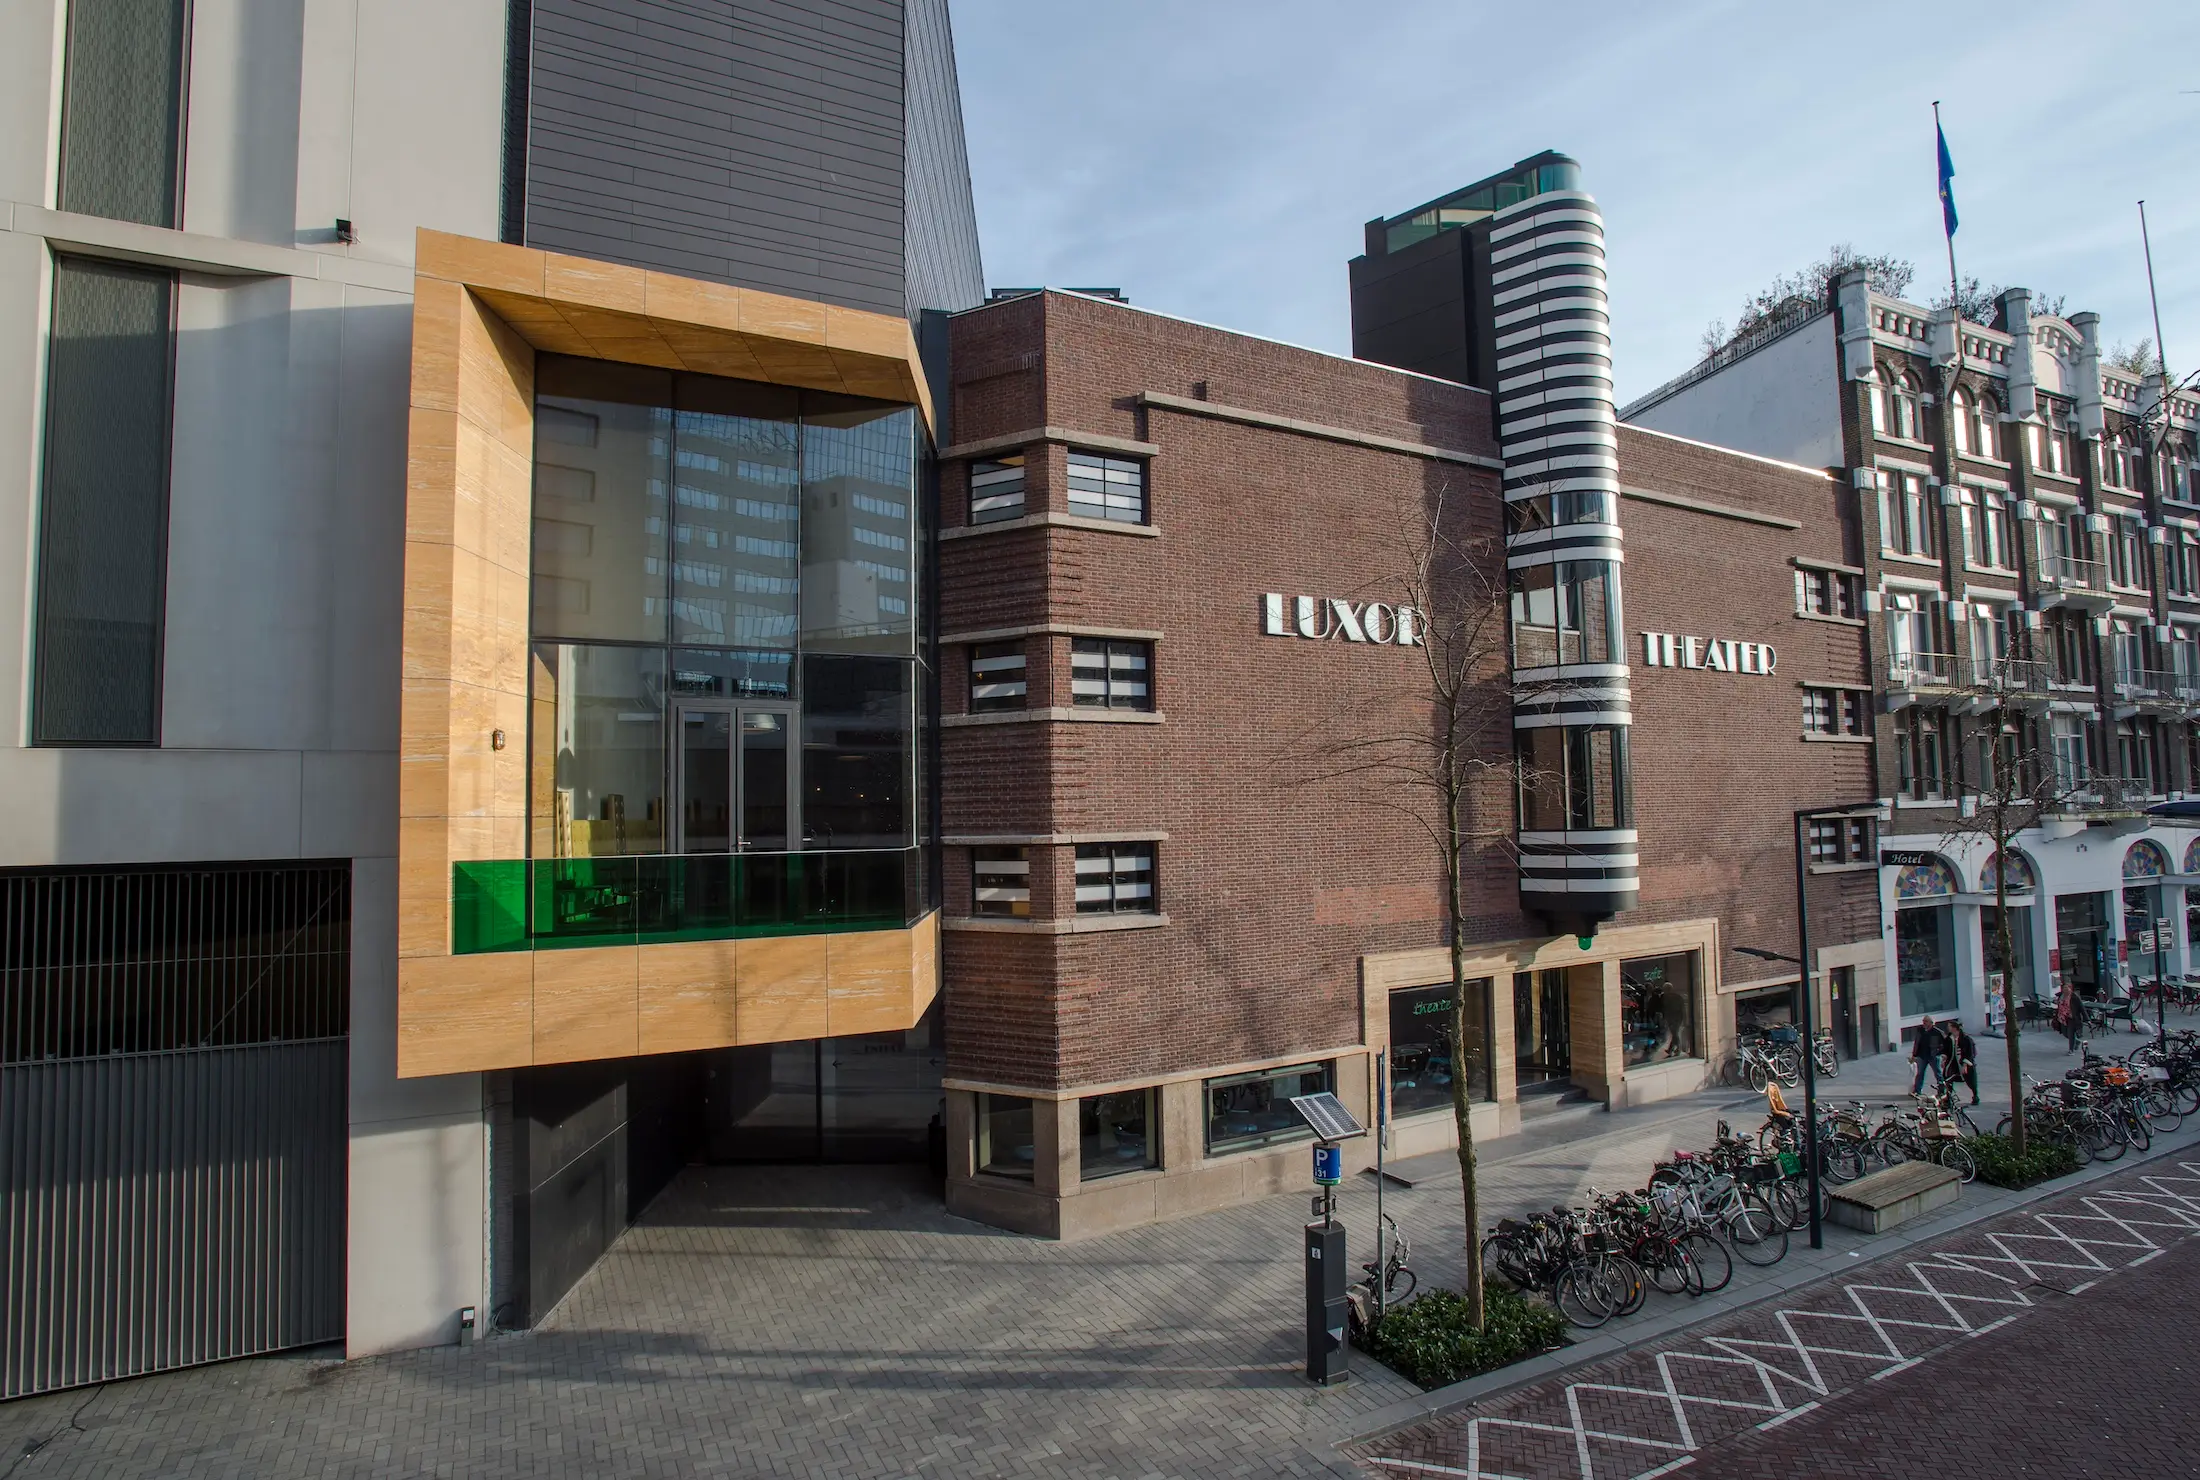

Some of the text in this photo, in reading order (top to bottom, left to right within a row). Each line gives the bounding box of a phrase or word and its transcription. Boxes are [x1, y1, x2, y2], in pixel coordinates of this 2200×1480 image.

[1266, 593, 1427, 646] LUXOR
[1641, 632, 1777, 676] THEATER
[1891, 853, 1924, 864] Hotel
[1412, 999, 1452, 1015] theate
[1316, 1149, 1328, 1167] P
